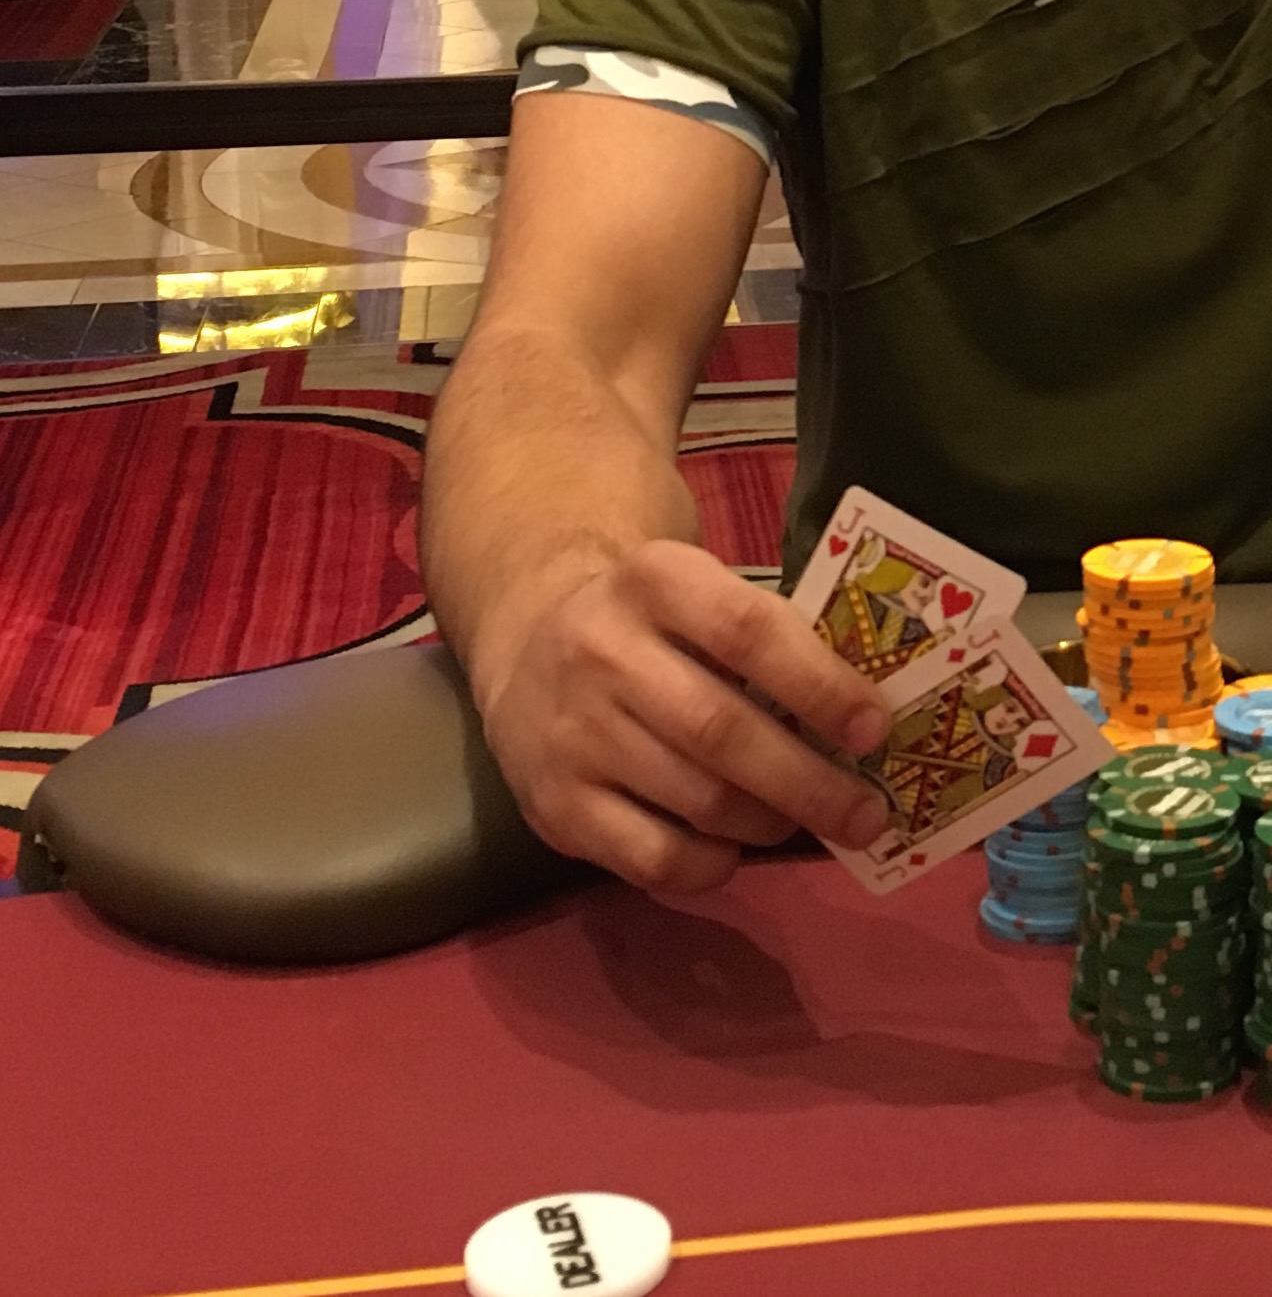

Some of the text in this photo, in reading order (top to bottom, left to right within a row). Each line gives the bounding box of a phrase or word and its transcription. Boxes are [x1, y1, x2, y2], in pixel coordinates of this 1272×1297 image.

[837, 506, 866, 535] J
[967, 628, 1001, 650] J
[535, 1202, 601, 1289] DEALER
